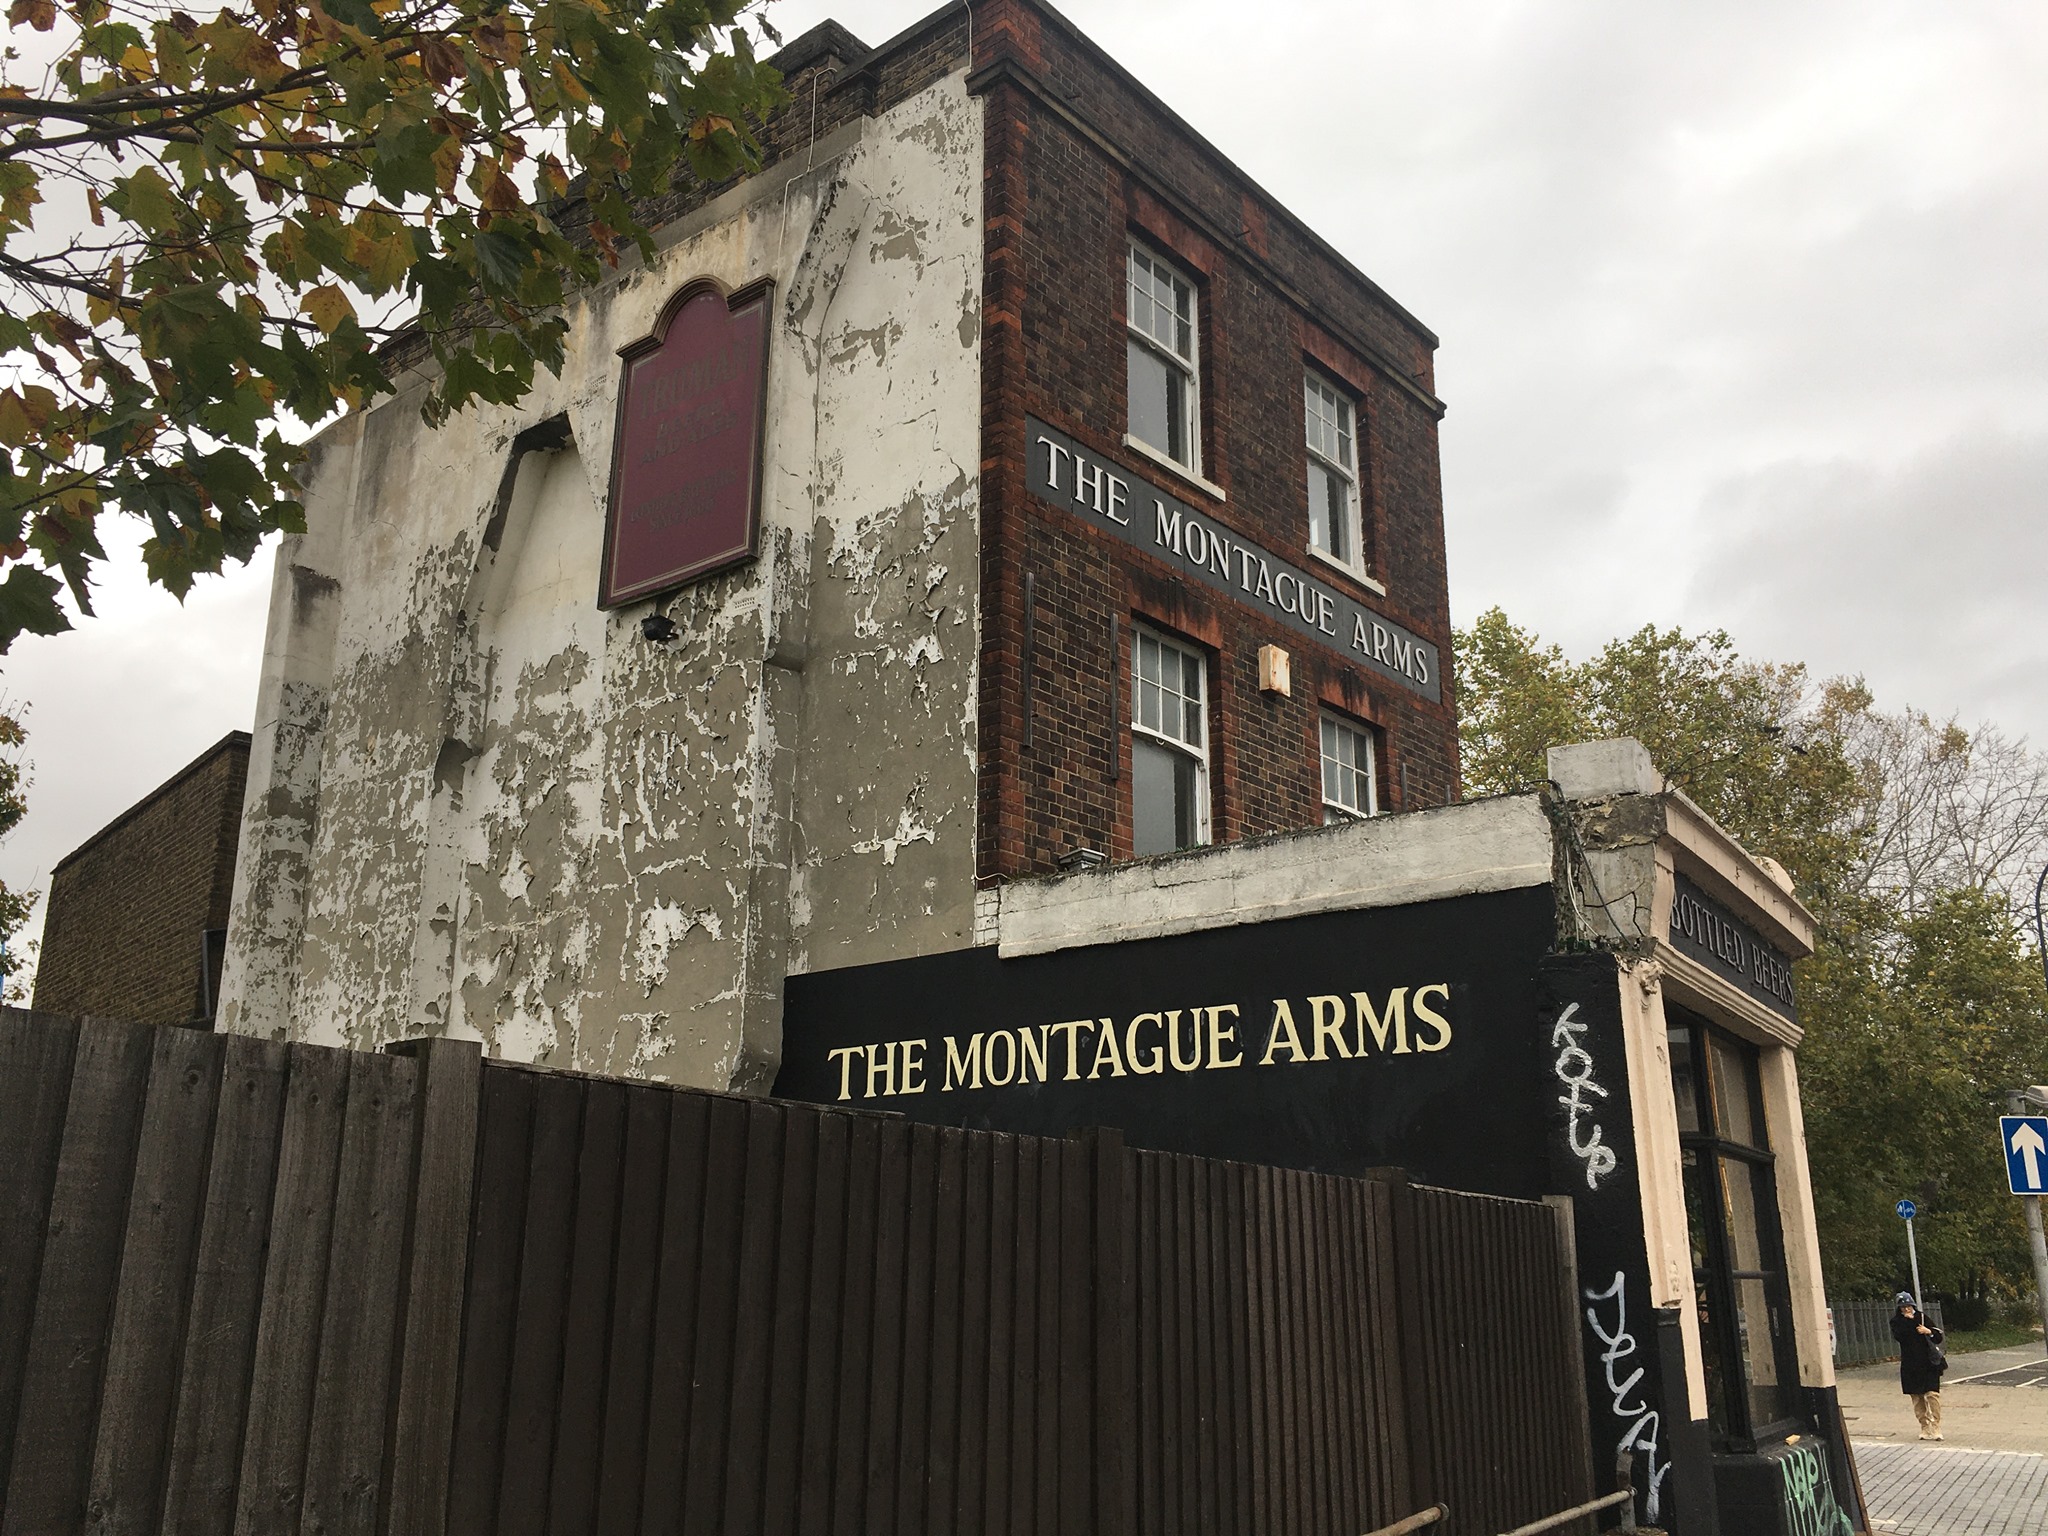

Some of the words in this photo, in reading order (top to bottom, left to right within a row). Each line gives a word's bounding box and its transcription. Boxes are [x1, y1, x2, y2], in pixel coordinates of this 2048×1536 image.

[1036, 436, 1130, 526] THE
[1154, 499, 1336, 637] MONTAGUE
[1351, 612, 1428, 685] ARMS
[1671, 892, 1745, 973] BOTTLED
[1752, 944, 1794, 1007] BEERS
[828, 1038, 927, 1101] THE
[942, 1003, 1243, 1092] MONTAGUE
[1258, 983, 1453, 1066] ARMS
